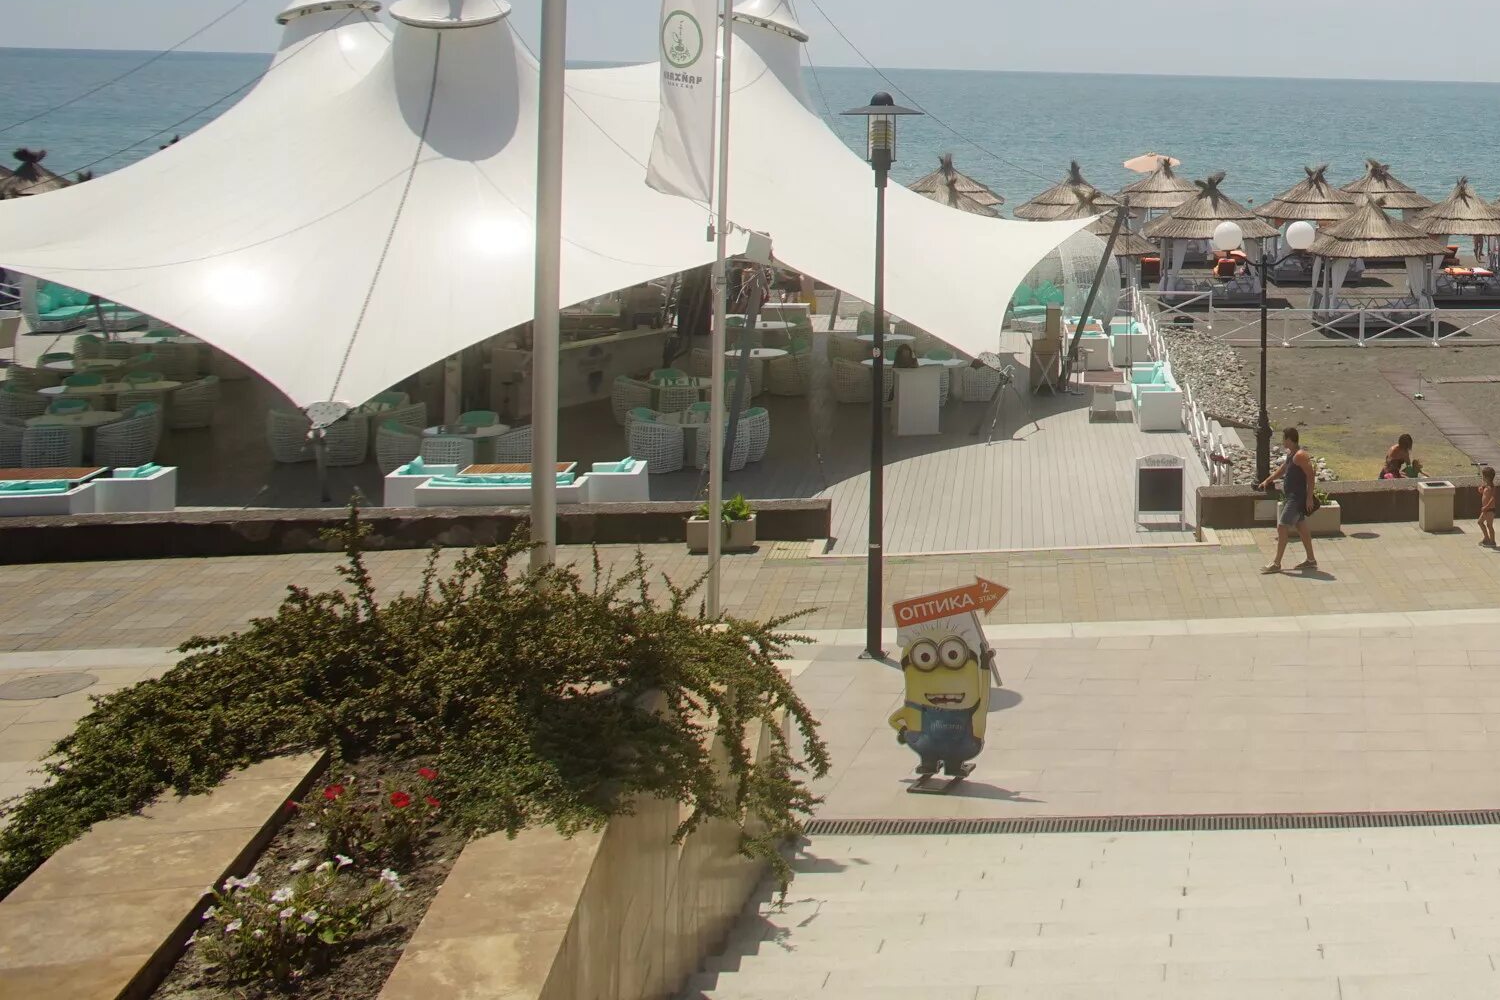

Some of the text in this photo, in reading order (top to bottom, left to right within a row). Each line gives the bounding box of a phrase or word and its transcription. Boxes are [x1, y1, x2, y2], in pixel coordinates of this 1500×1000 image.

[981, 582, 990, 594] 2
[979, 593, 998, 604] ЭТАЖ
[900, 593, 975, 621] ОПТИКА
